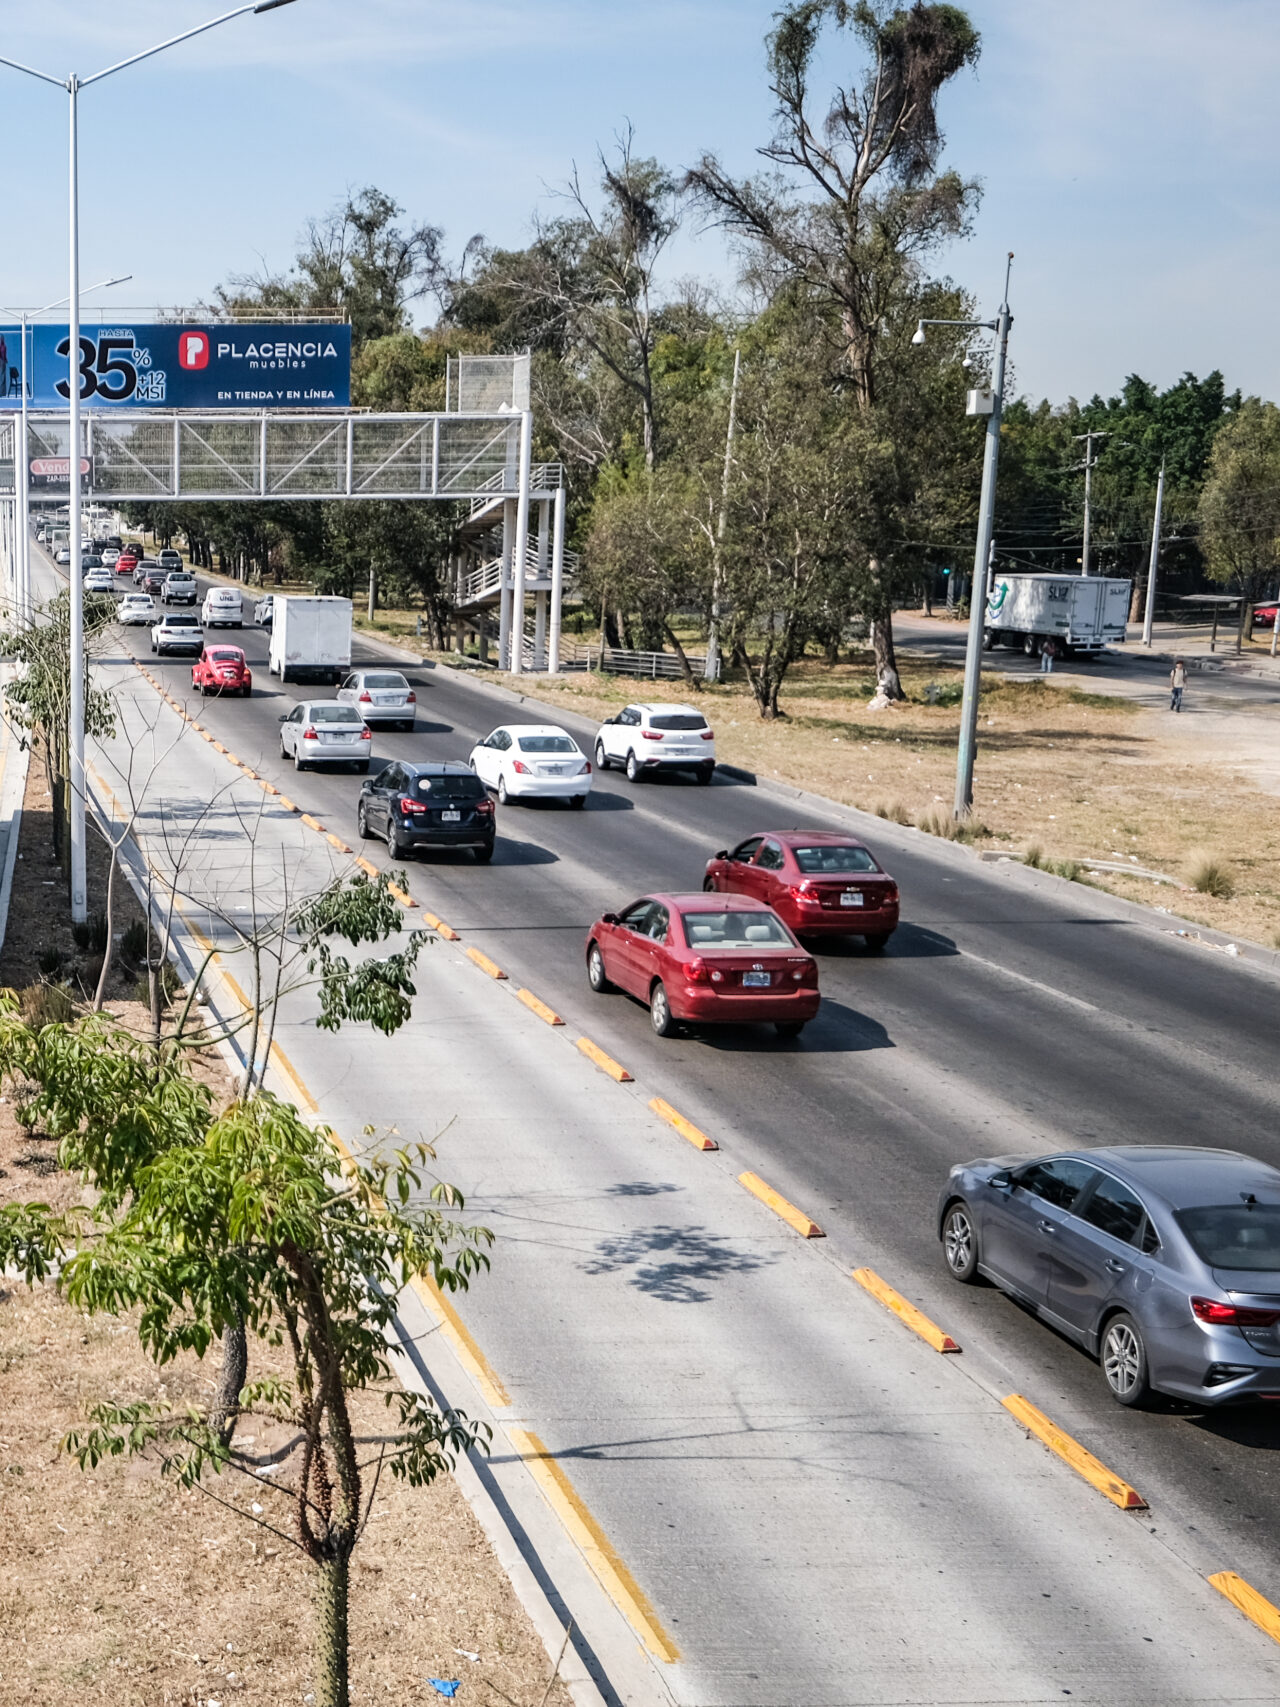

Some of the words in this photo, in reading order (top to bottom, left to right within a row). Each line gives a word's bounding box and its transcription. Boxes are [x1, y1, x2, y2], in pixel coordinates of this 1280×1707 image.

[99, 328, 134, 337] HASTA
[217, 343, 338, 358] PLACENCIA
[55, 337, 137, 401] 35
[249, 358, 307, 369] muebles
[137, 371, 165, 386] +12
[136, 386, 164, 400] MSI
[218, 391, 232, 399] EN
[235, 391, 274, 399] TIENDA
[277, 391, 284, 399] Y
[286, 391, 301, 399] EN
[304, 388, 335, 399] LÍNEA
